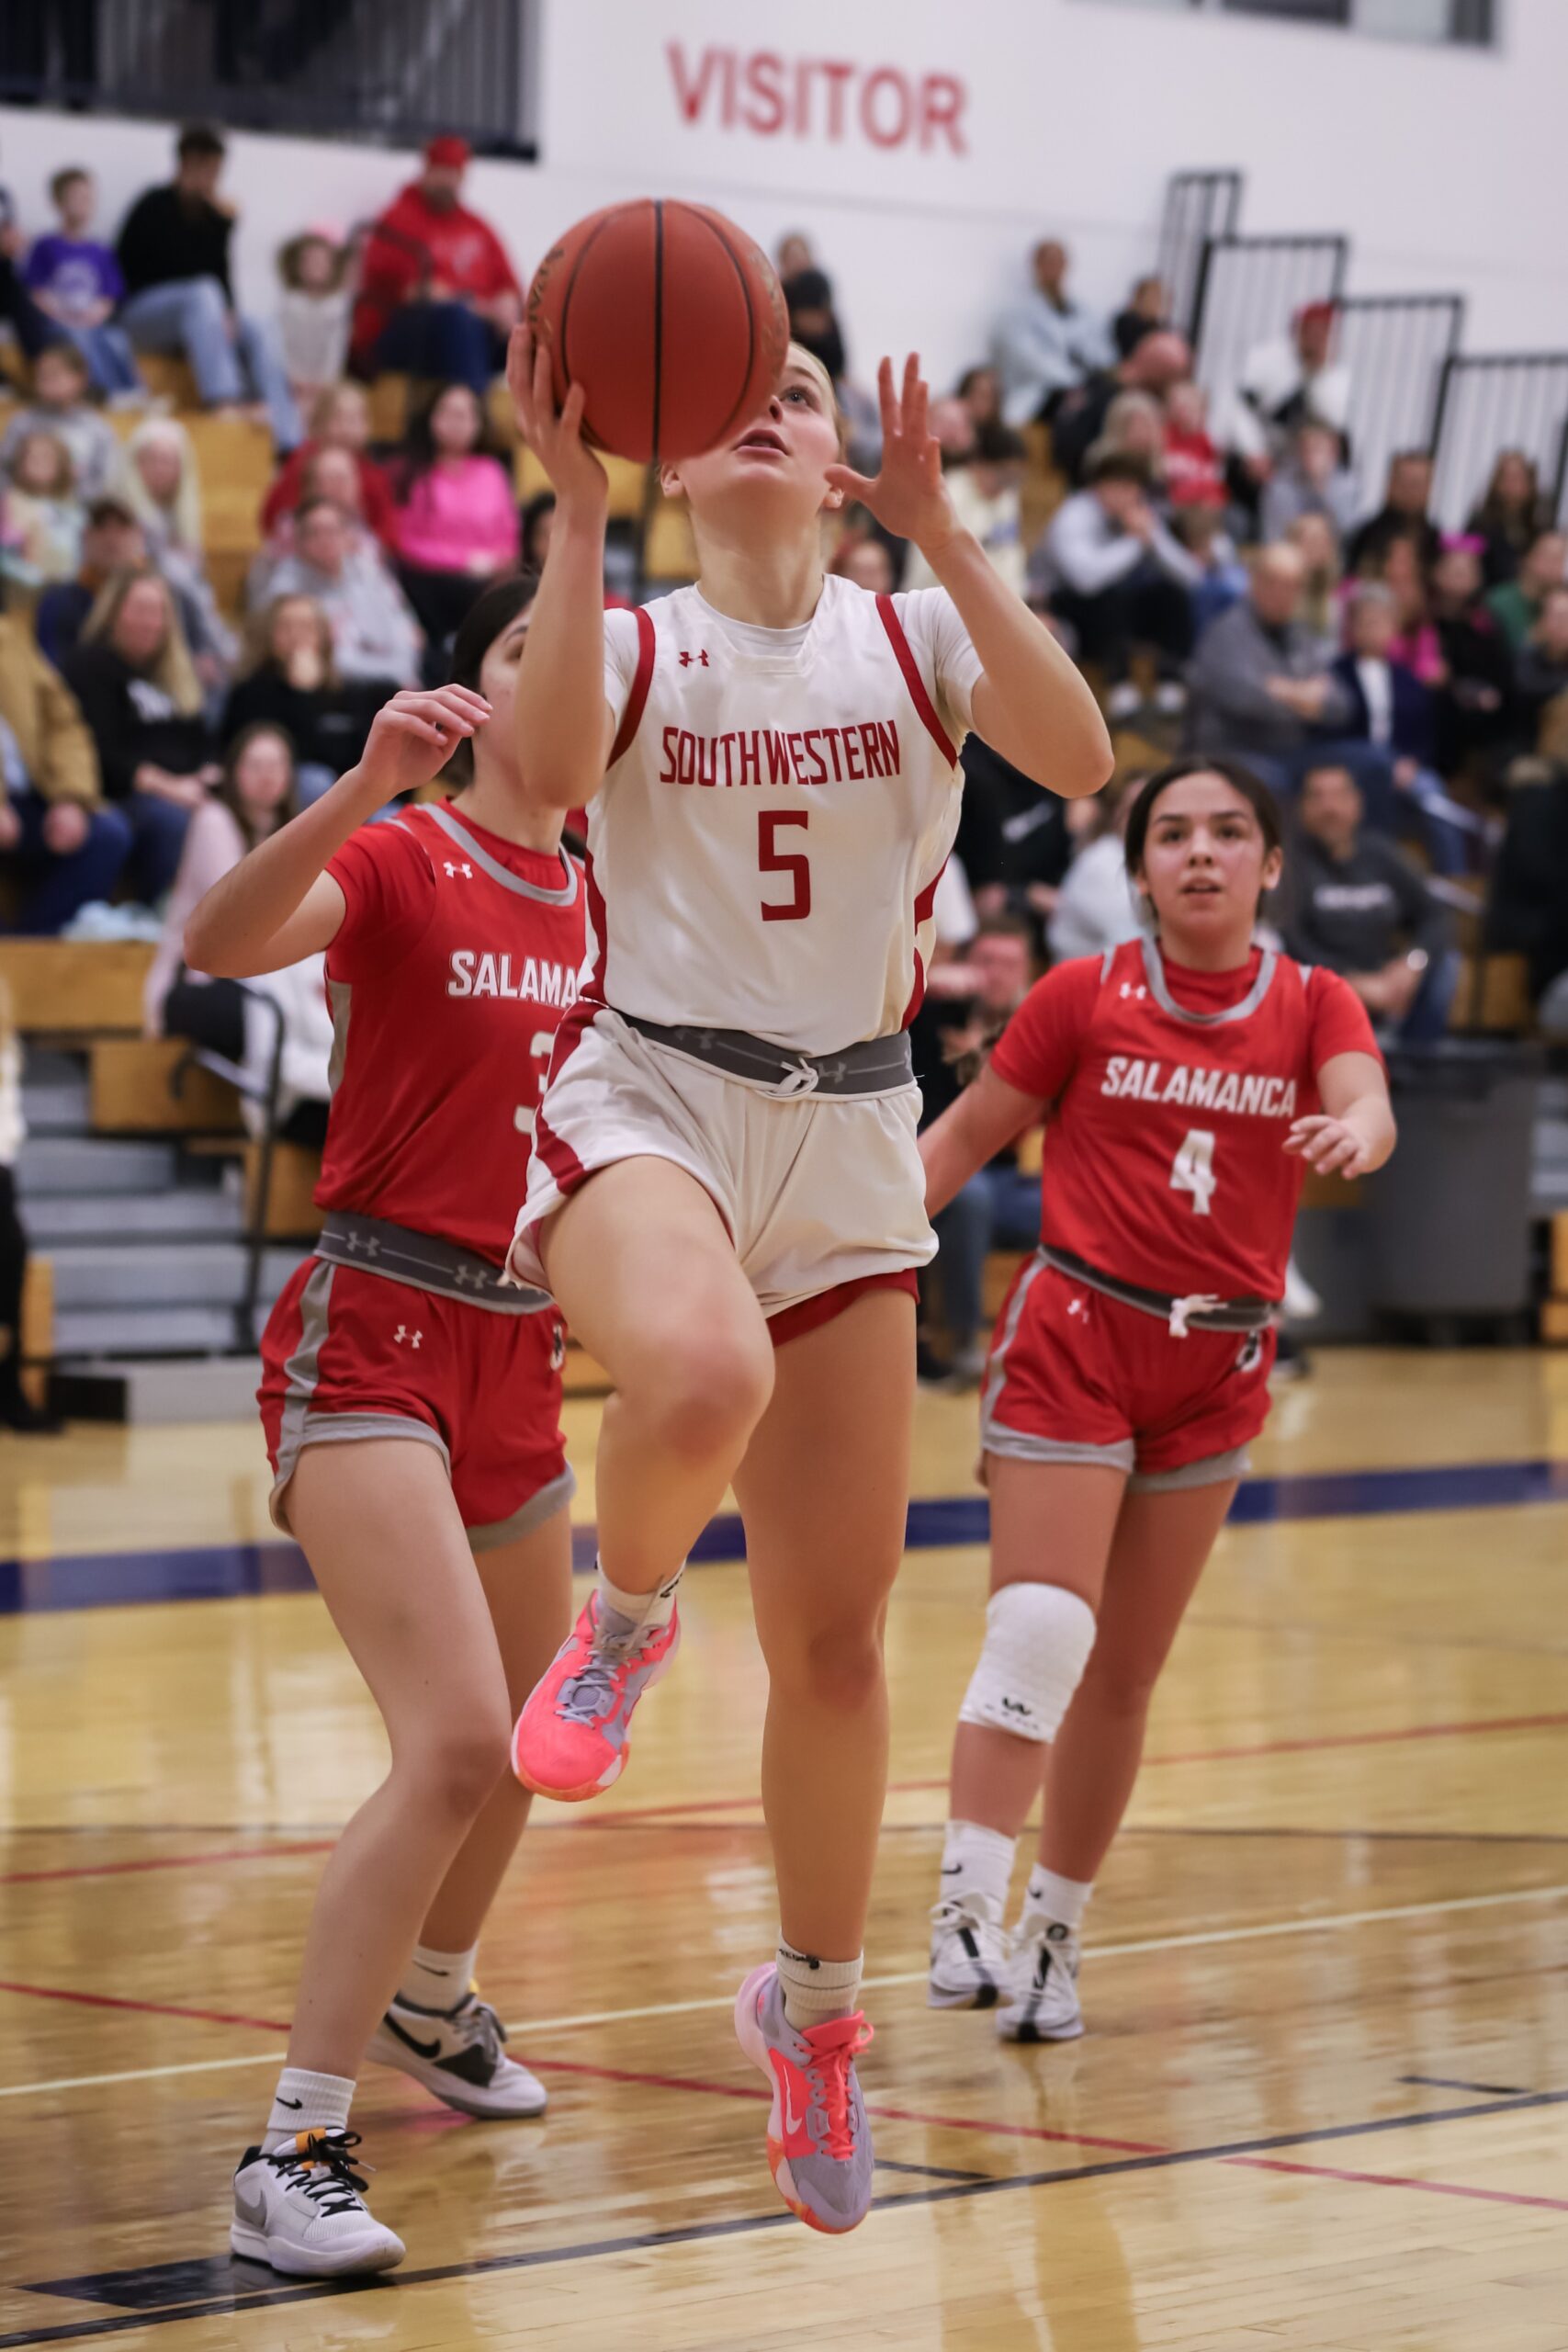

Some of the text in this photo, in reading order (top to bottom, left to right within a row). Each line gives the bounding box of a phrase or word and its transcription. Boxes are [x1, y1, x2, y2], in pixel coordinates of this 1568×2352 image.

[665, 40, 969, 156] VISITOR
[660, 720, 900, 787] SOUTHWESTERN
[758, 810, 811, 922] 5
[447, 950, 595, 1009] SALAMA
[1100, 1057, 1297, 1118] SALAMANCA
[1169, 1128, 1217, 1216] 4
